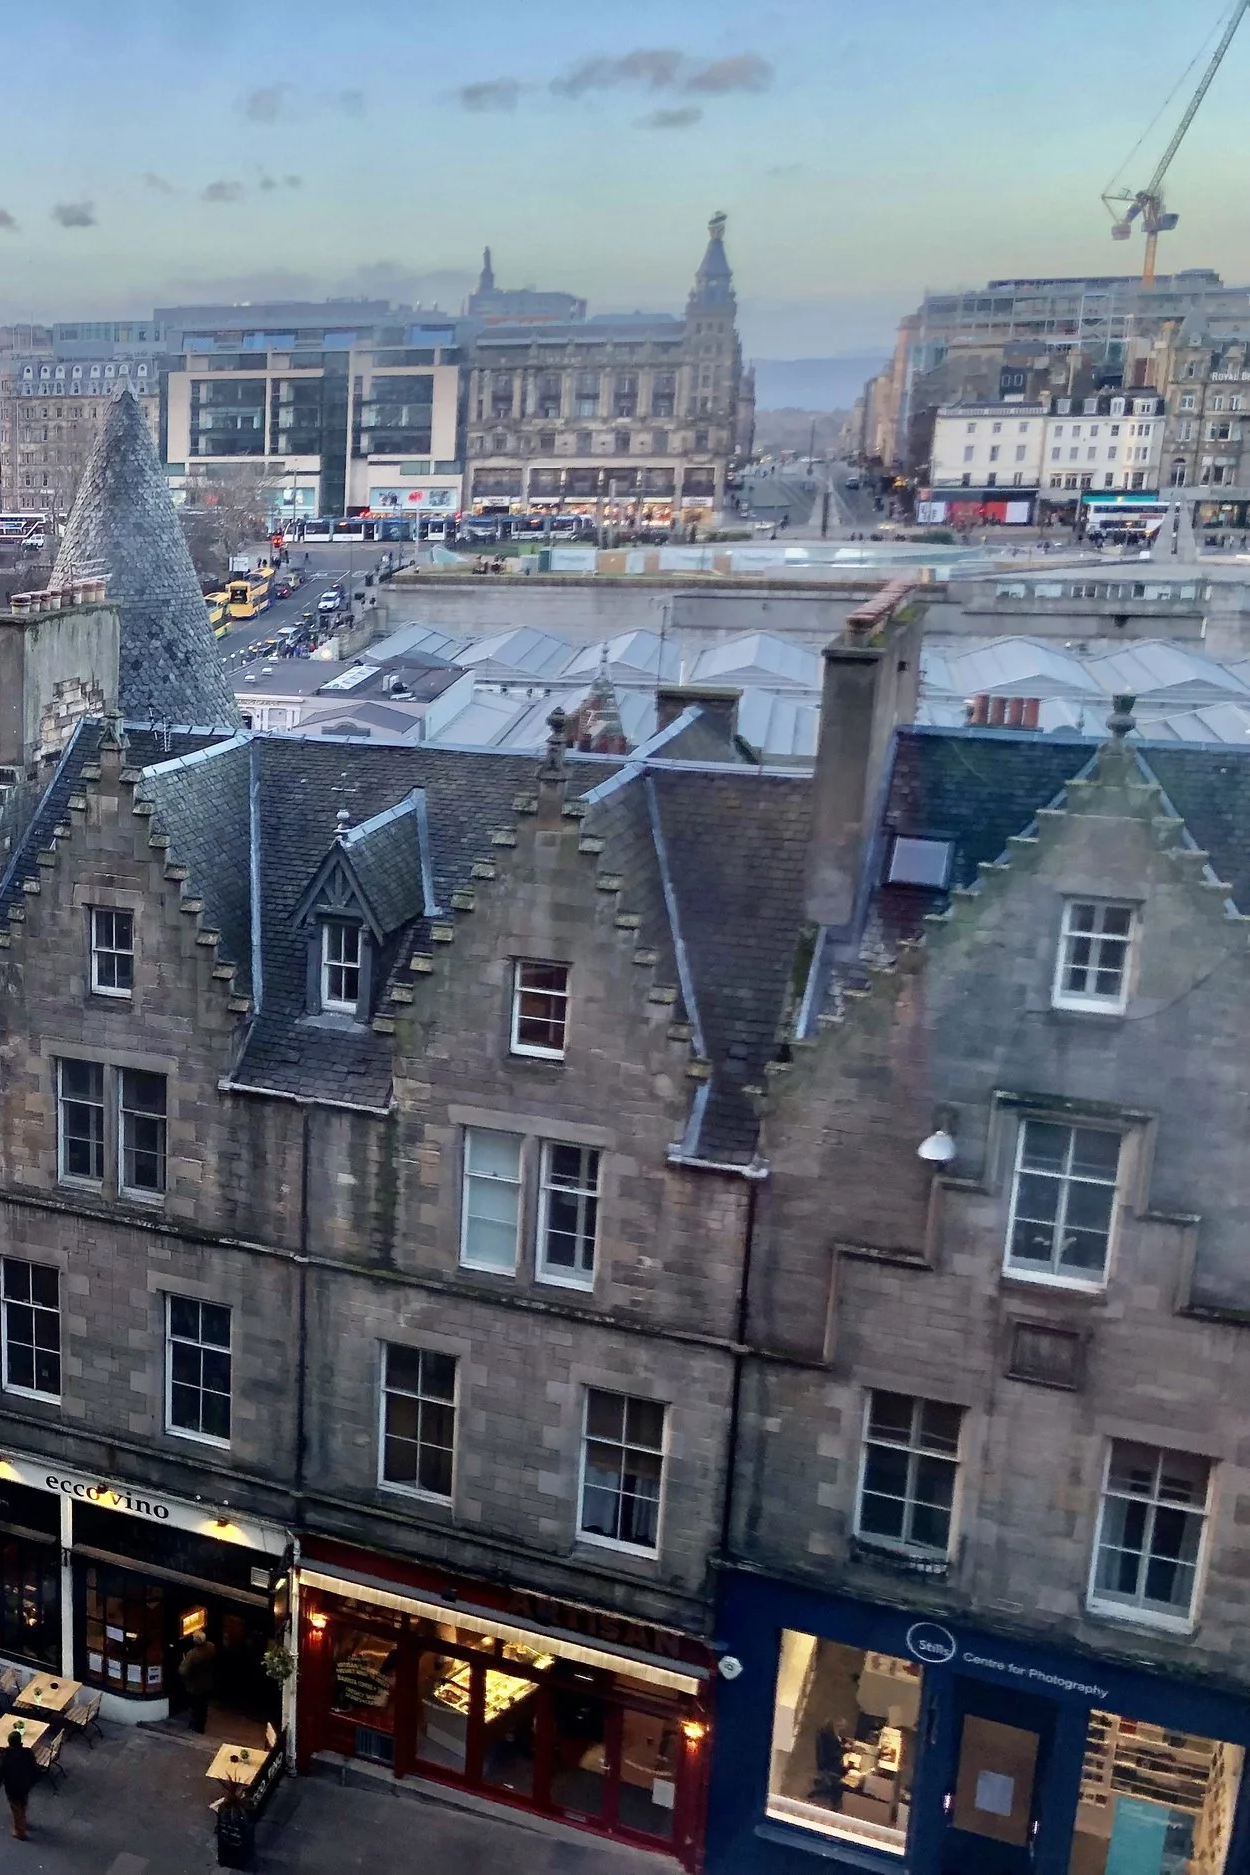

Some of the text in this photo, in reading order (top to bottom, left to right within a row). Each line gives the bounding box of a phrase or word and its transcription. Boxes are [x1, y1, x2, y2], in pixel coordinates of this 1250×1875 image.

[1212, 371, 1239, 381] ROYAL
[46, 1475, 169, 1519] ecco vino
[506, 1592, 681, 1660] ARTISAN
[918, 1639, 951, 1657] Stills
[963, 1652, 1109, 1699] Centre for Photography
